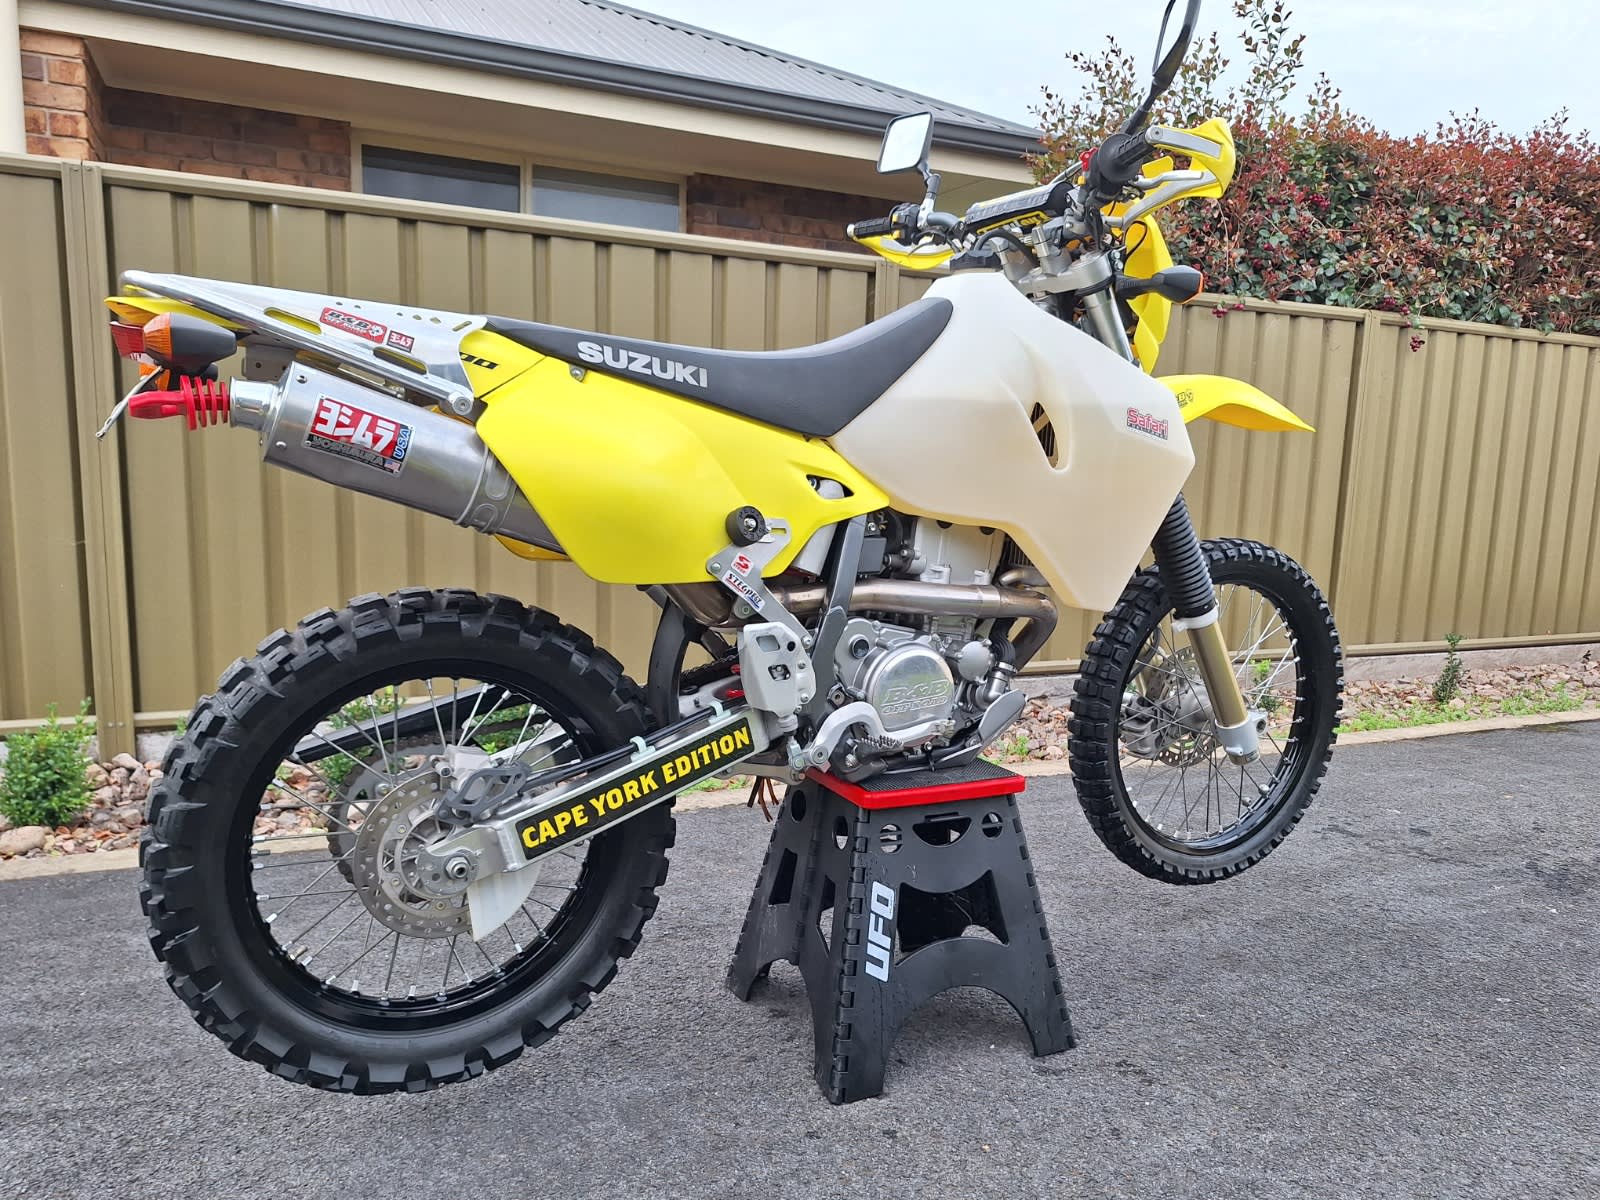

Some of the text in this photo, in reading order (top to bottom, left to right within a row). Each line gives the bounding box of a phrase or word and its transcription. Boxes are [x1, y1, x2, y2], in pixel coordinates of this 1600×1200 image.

[577, 341, 708, 388] SUZUKI
[315, 399, 397, 453] ヨシムラ
[393, 427, 411, 460] USA
[1126, 407, 1169, 437] Safari
[521, 726, 750, 849] CAPE YORK EDITION
[865, 881, 895, 983] UFO
